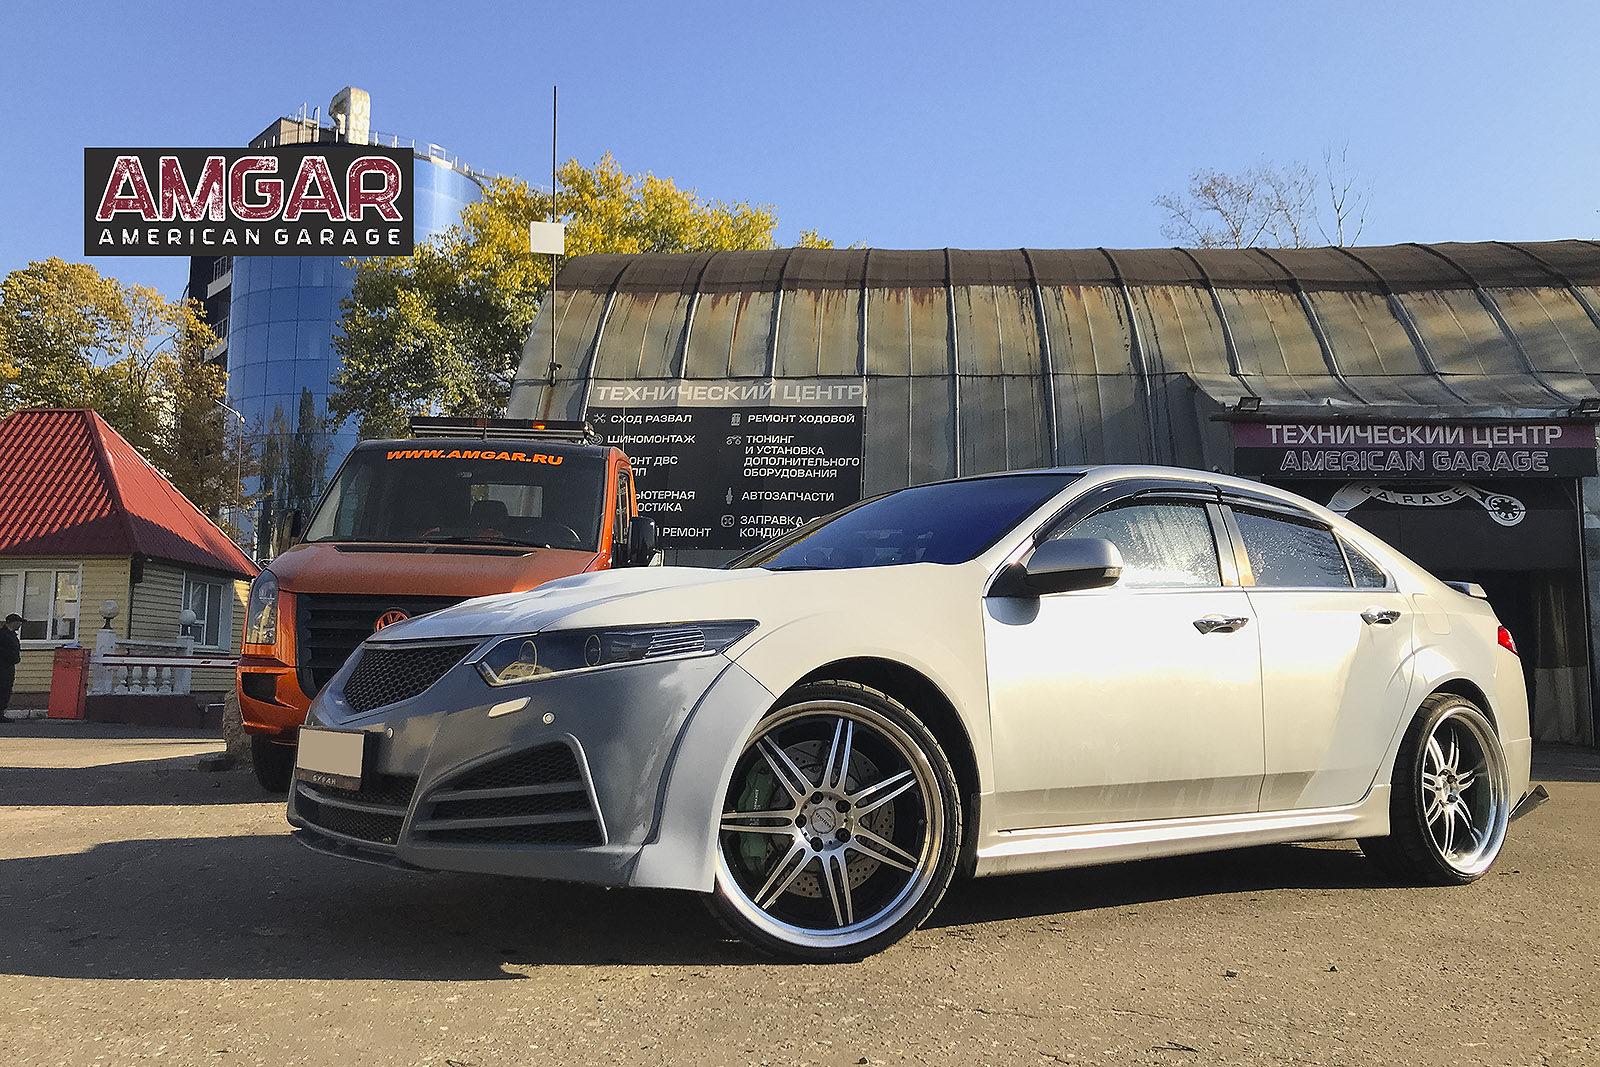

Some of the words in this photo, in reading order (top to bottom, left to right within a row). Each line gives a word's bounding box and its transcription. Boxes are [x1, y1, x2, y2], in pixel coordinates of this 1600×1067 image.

[597, 382, 776, 401] ТЕХНИЧЕСКИЙ
[783, 385, 863, 403] ЦЕНТР
[610, 414, 642, 425] СХОД
[645, 414, 692, 424] РАЗВАЛ
[748, 414, 796, 424] РЕМОНТ
[798, 413, 855, 425] ХОДОВОЙ
[607, 434, 696, 445] ШИНОМОНТАЖ
[746, 435, 794, 445] ТЮНИНГ
[1472, 424, 1564, 449] ЦЕНТР
[745, 446, 754, 456] И
[757, 446, 824, 456] УСТАНОВКА
[386, 449, 564, 466] WWW.AMGAR.RU
[653, 456, 679, 467] ДВС
[743, 457, 860, 468] ДОПОЛНИТЕЛЬНОГО
[1280, 450, 1426, 473] AMERICAN
[1432, 450, 1550, 473] GARAGE
[743, 468, 838, 479] ОБОРУДОВАНИЯ
[741, 491, 835, 502] АВТОЗАПЧАСТИ
[1360, 485, 1467, 505] GARAGE
[637, 502, 683, 513] ОСТИКА
[740, 515, 804, 526] ЗАПРАВКА
[662, 527, 712, 538] РЕМОНТ
